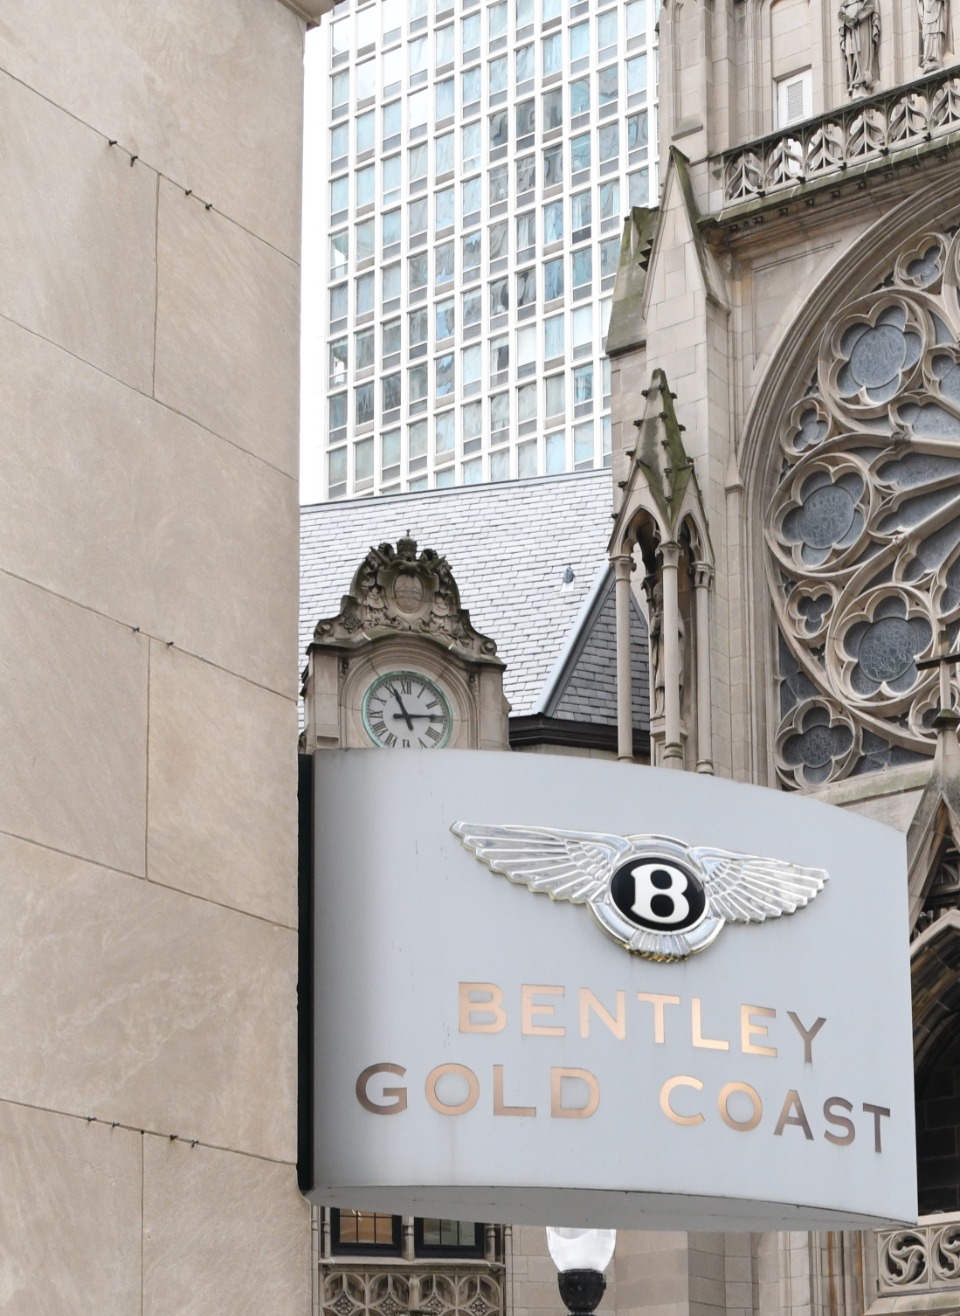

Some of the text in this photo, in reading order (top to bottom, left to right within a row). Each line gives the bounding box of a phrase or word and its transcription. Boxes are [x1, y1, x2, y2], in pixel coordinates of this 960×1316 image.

[630, 863, 690, 924] B
[457, 981, 828, 1064] BENTLEY
[355, 1062, 891, 1154] GOLD COAST
